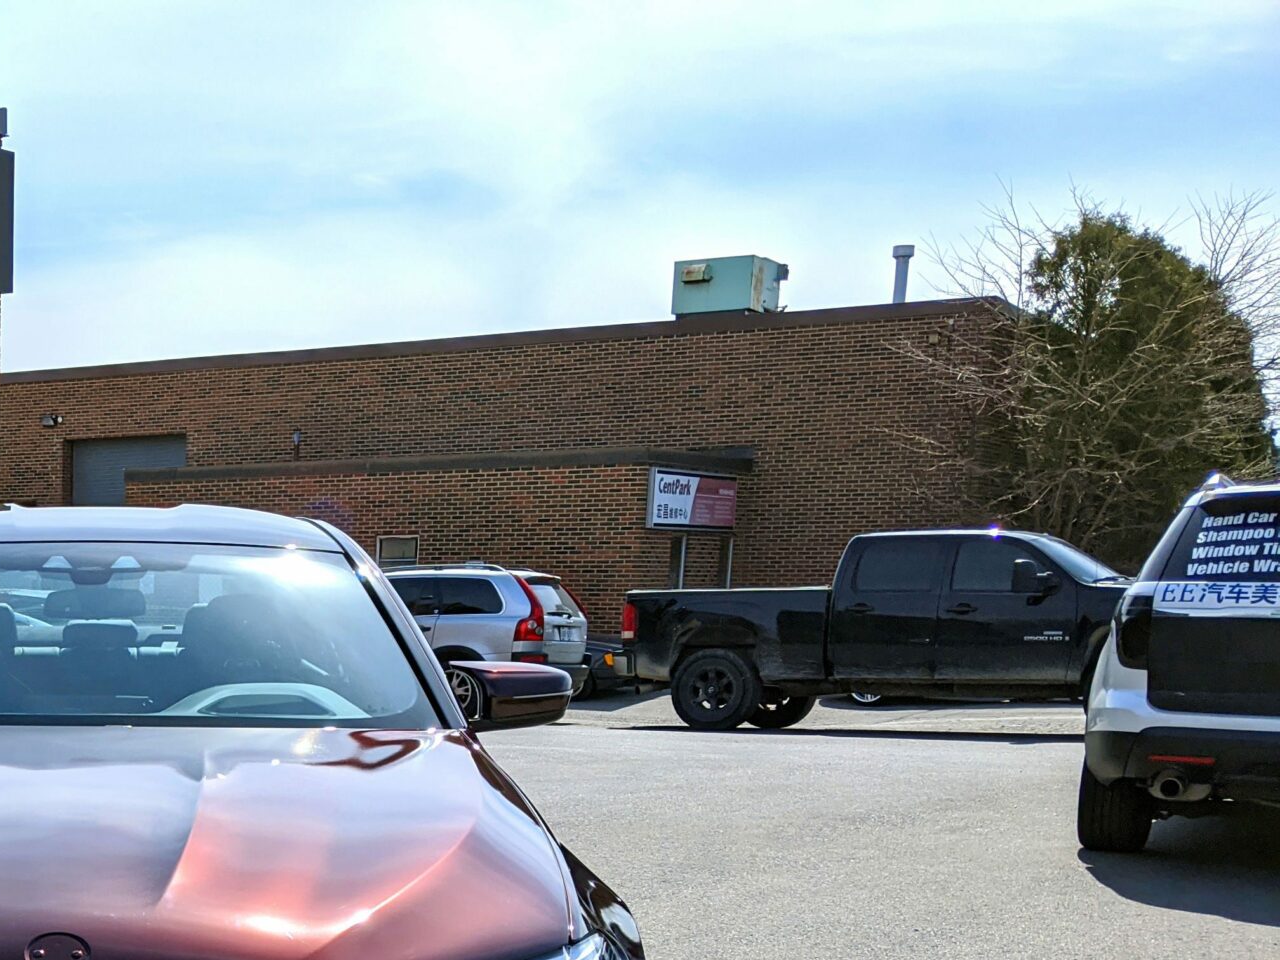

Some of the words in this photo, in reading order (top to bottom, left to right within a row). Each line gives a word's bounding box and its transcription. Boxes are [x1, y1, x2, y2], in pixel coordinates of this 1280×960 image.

[658, 477, 692, 496] CentPark
[1202, 513, 1246, 528] Hand
[1247, 512, 1278, 524] Car
[1196, 528, 1276, 543] Shampoo
[1191, 544, 1260, 559] Window
[1186, 561, 1250, 576] Vehicle
